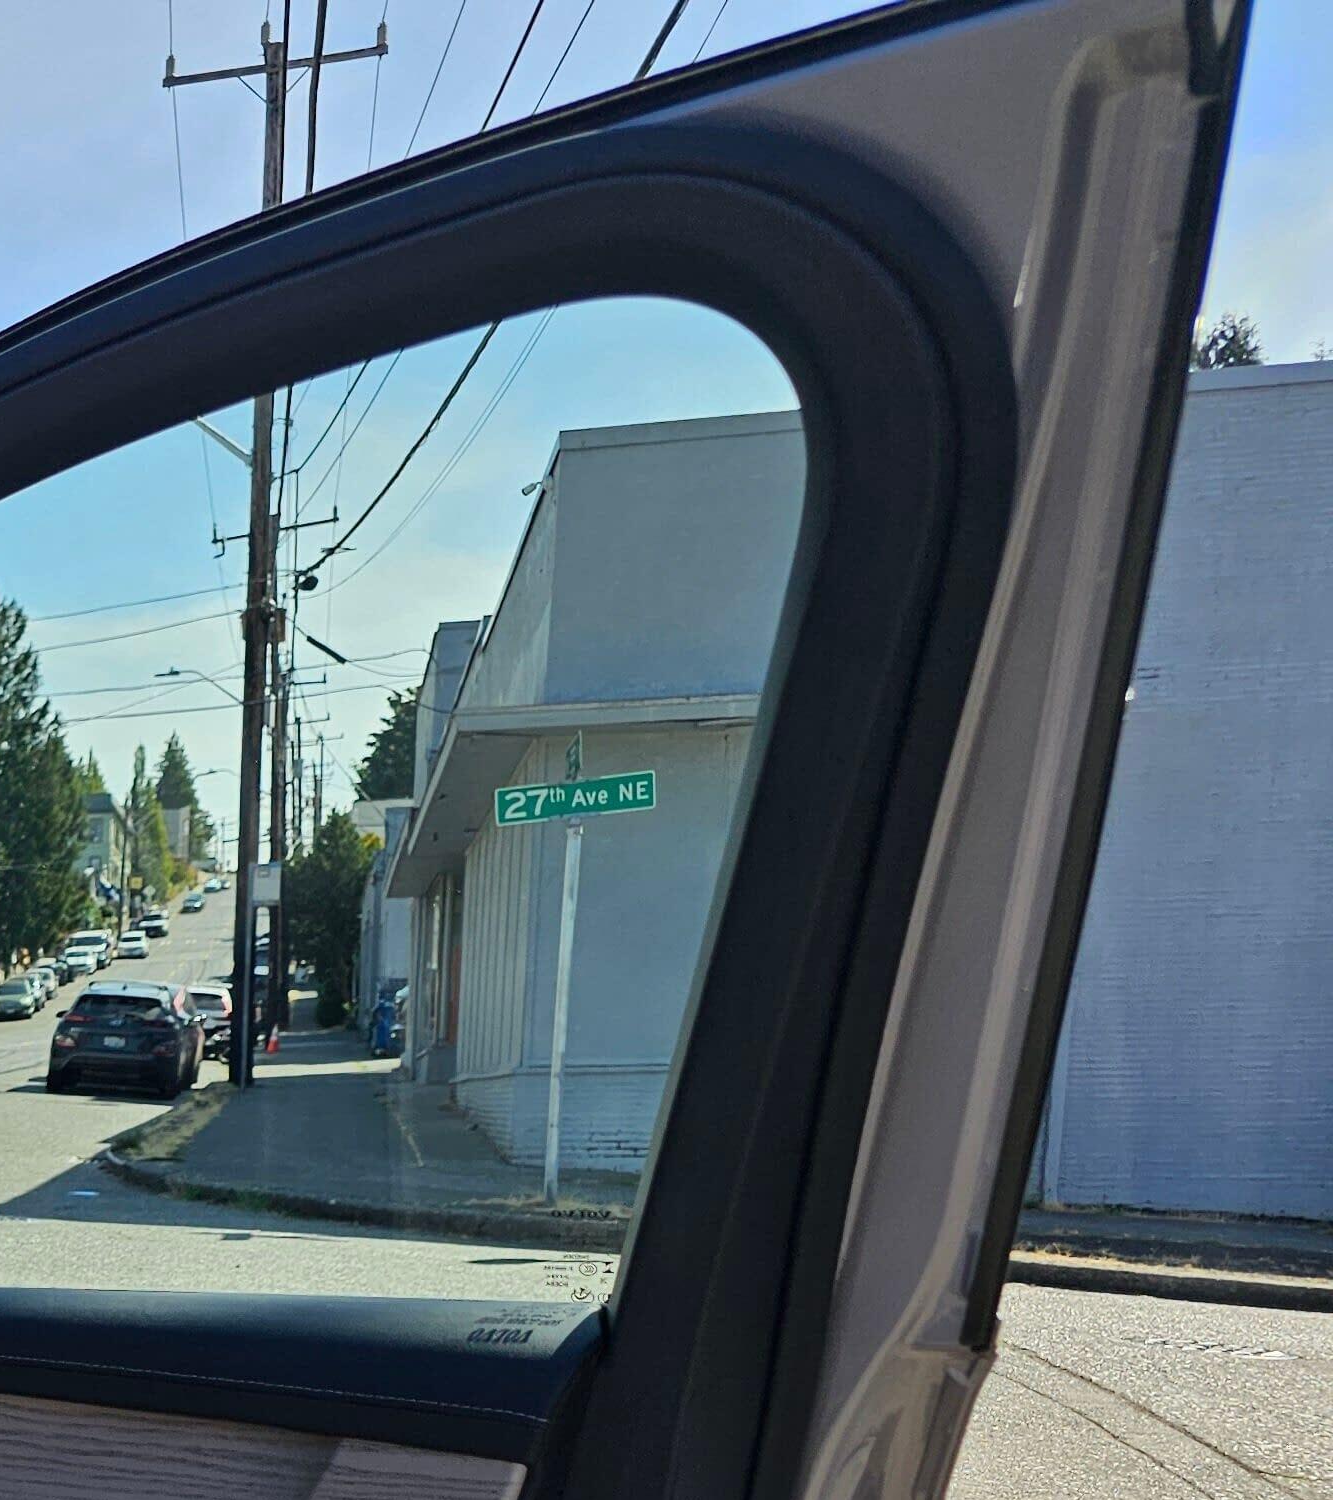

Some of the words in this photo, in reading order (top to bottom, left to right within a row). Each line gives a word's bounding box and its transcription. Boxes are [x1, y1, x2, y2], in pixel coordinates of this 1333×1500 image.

[504, 787, 565, 819] 27th
[572, 789, 608, 807] Ave
[619, 781, 649, 802] NE
